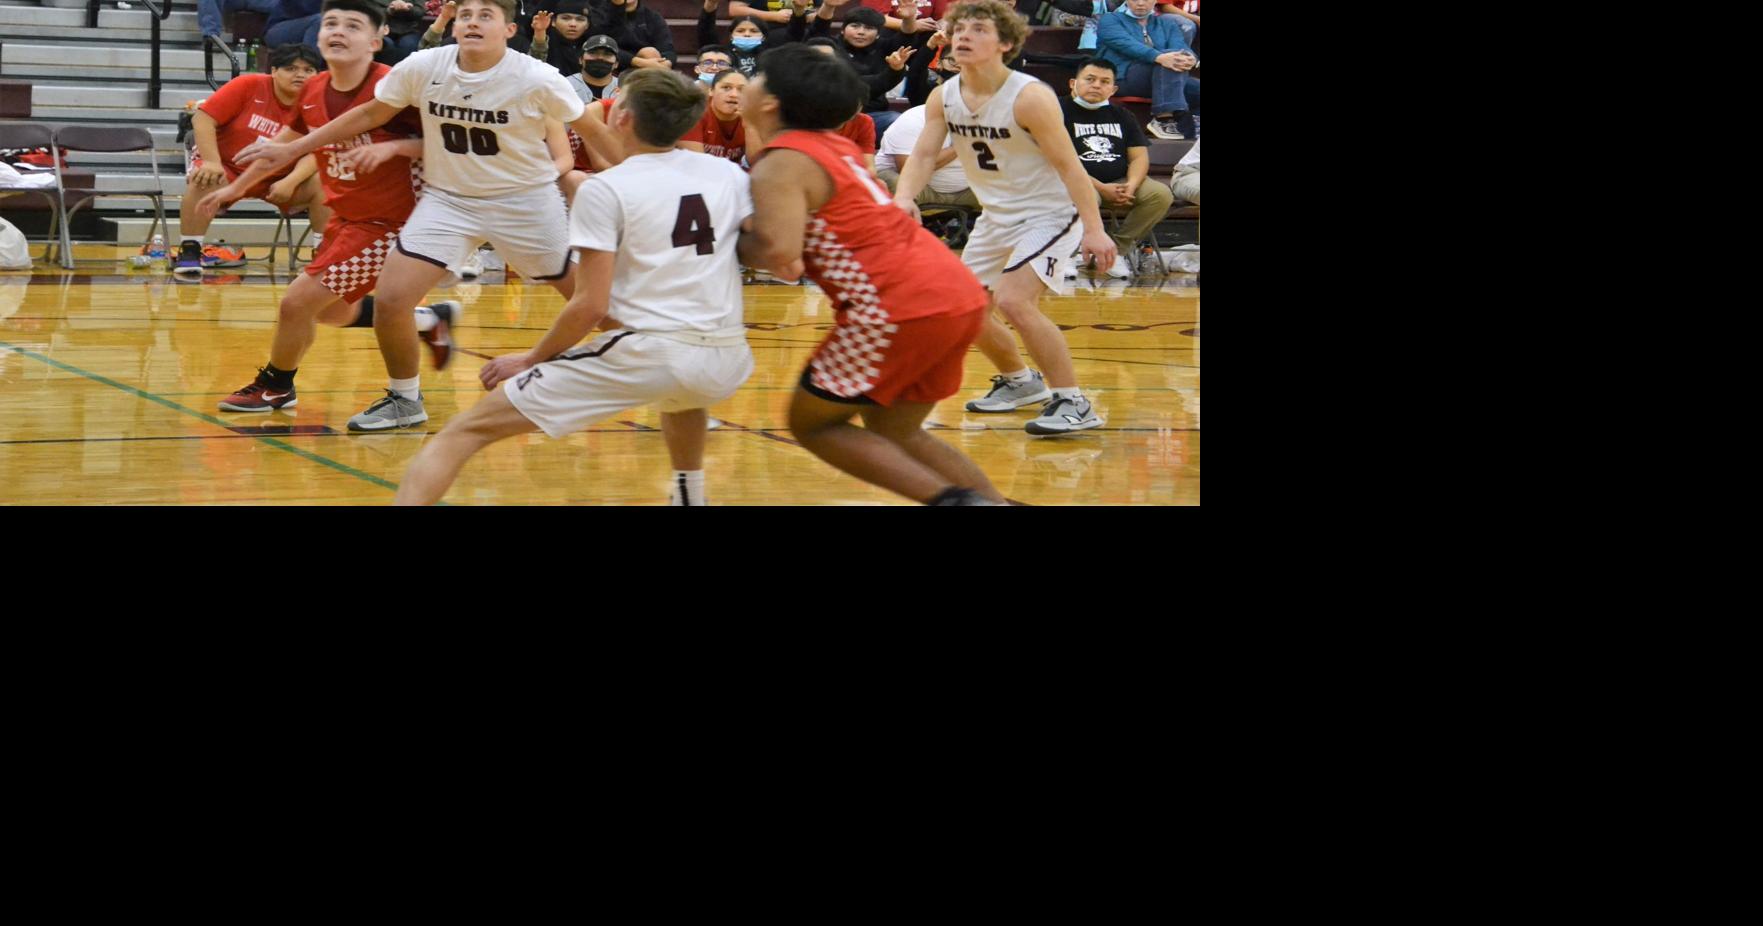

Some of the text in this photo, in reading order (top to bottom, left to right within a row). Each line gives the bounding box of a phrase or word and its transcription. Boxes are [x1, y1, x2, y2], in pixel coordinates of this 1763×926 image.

[248, 113, 280, 136] WHITE
[428, 101, 509, 124] KITTITAS
[441, 123, 501, 155] 00
[1073, 122, 1123, 139] WHITE SWAN
[322, 150, 357, 181] 32
[972, 141, 999, 171] 2
[671, 193, 716, 256] 4
[1046, 256, 1058, 277] K
[516, 367, 543, 391] K
